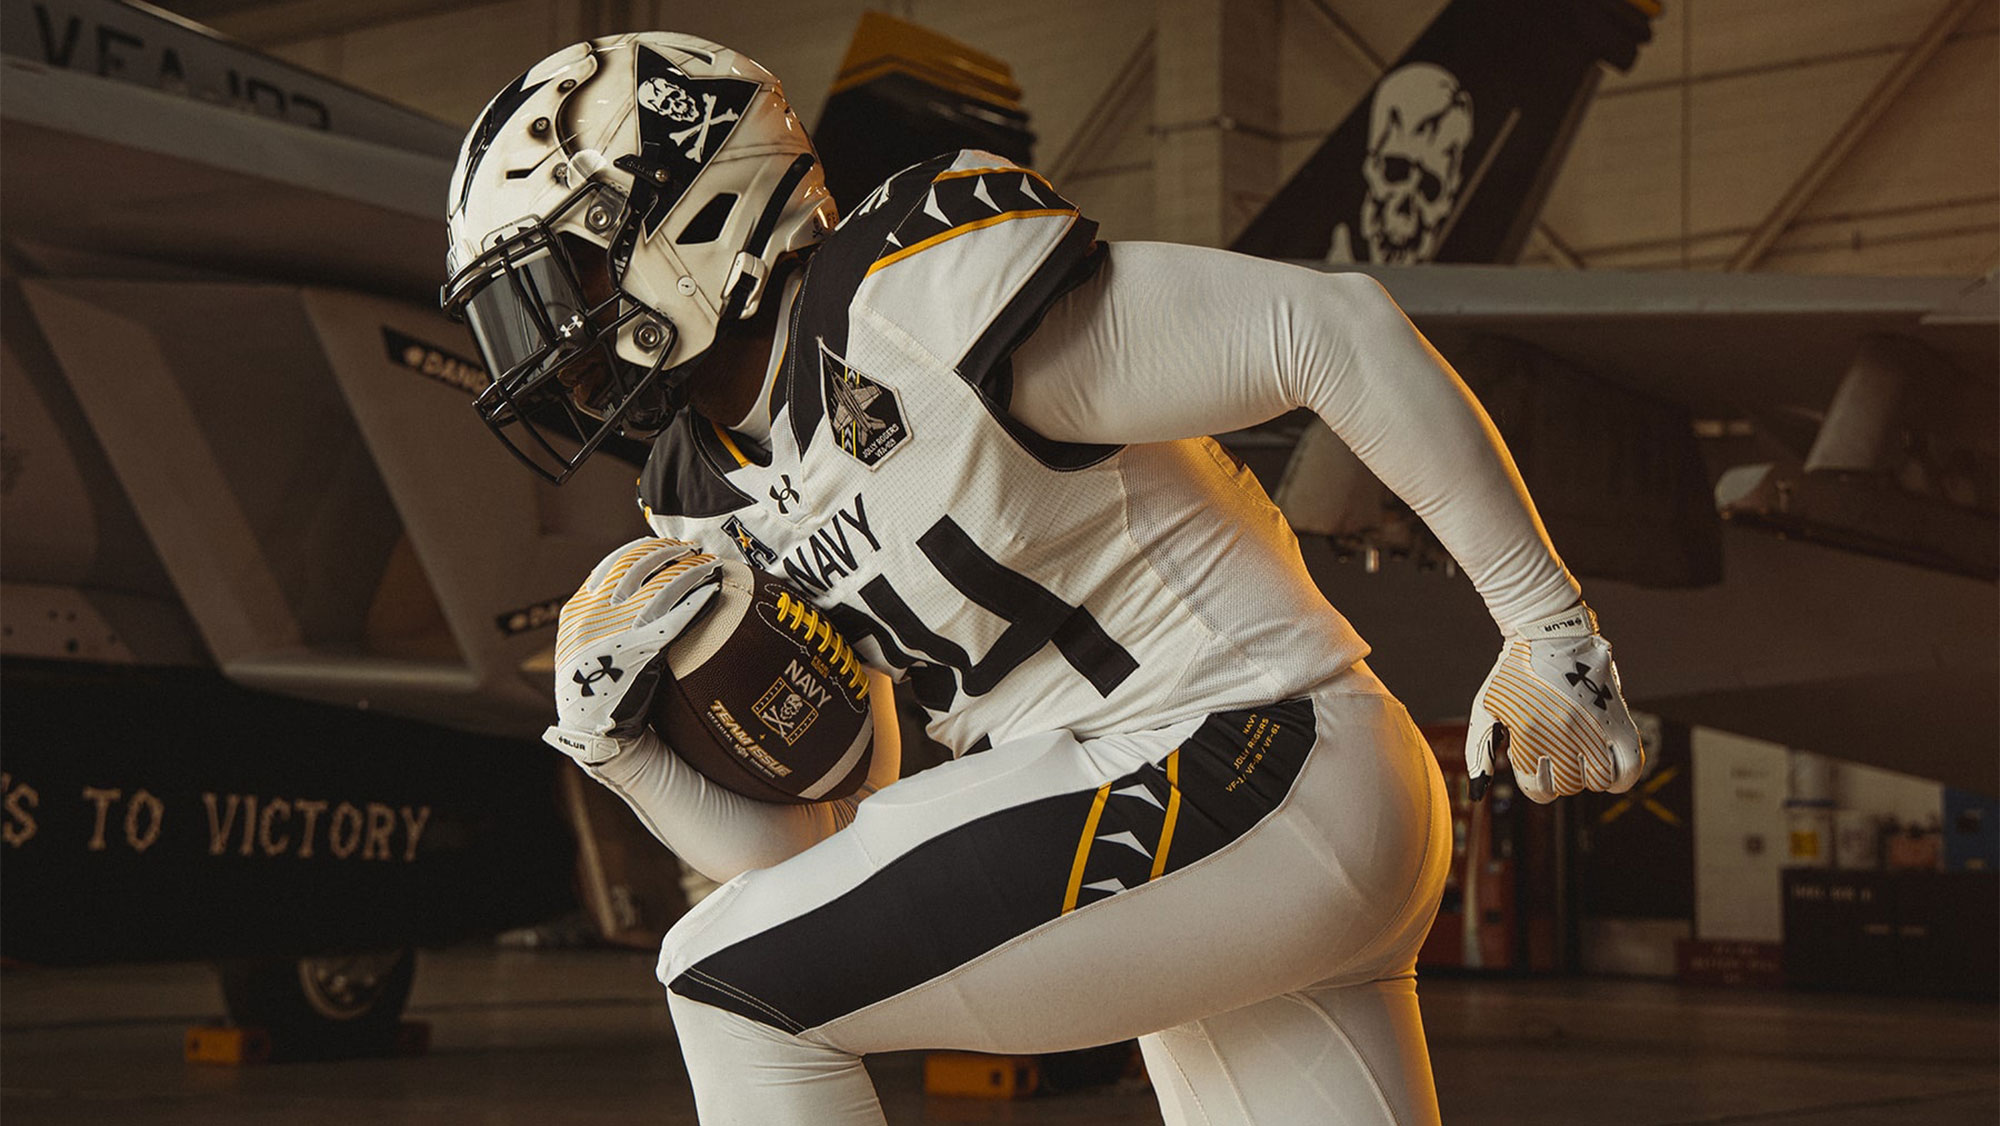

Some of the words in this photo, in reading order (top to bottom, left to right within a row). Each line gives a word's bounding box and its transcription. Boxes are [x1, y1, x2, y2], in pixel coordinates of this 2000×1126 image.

[783, 493, 881, 598] NAVY
[1544, 619, 1575, 632] BLUR
[784, 659, 832, 708] NAVY
[563, 738, 585, 751] BLUR
[710, 699, 755, 746] TEAM
[746, 743, 793, 777] ISSUE
[1233, 748, 1250, 770] JOLLY
[82, 786, 164, 852] TO
[203, 792, 430, 862] VICTORY
